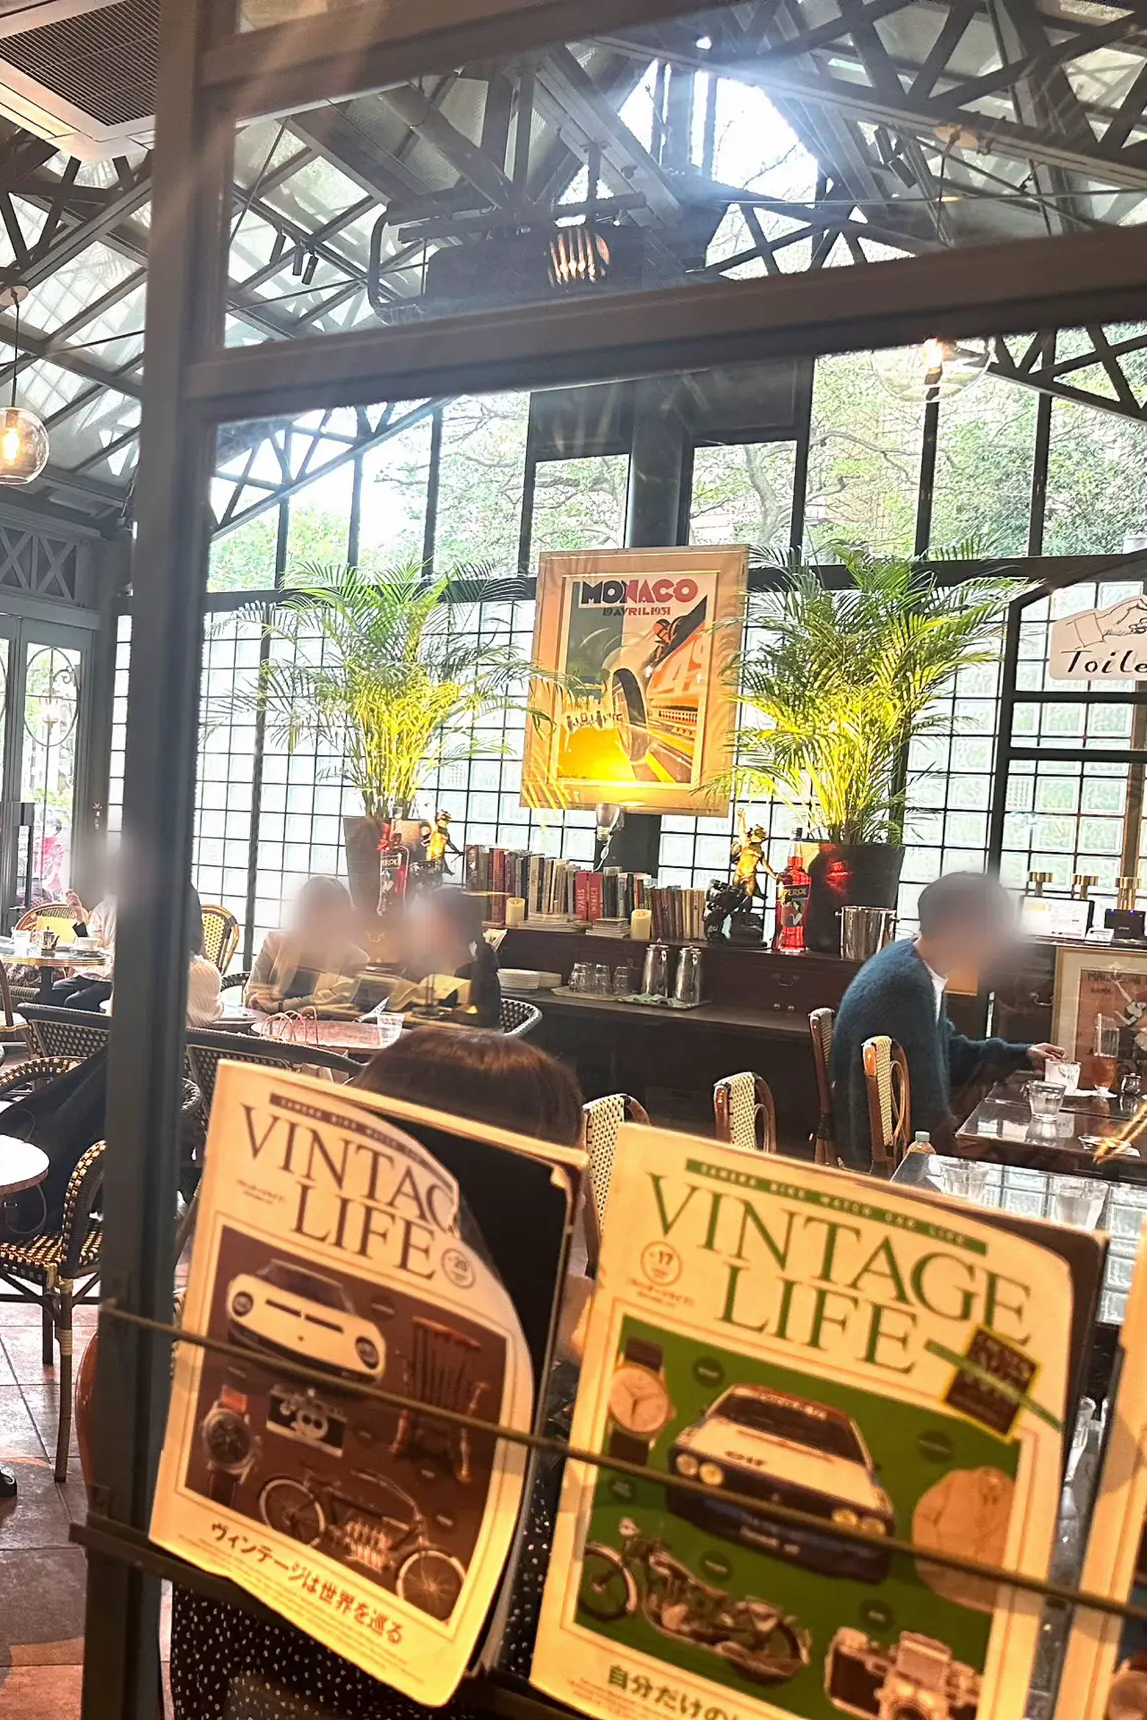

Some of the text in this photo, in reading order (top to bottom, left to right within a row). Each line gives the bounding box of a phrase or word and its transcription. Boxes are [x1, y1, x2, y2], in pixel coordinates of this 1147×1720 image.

[581, 578, 698, 604] MONACO
[613, 607, 650, 616] AVRIL
[1061, 649, 1147, 674] Toile
[291, 1181, 437, 1280] LIFE
[646, 1170, 1032, 1347] VINTAGE
[658, 1250, 673, 1266] 17
[713, 1261, 919, 1376] LIFE
[211, 1521, 404, 1645] ヴィンテージは世界を巡る
[608, 1664, 739, 1720] 自分だけの
